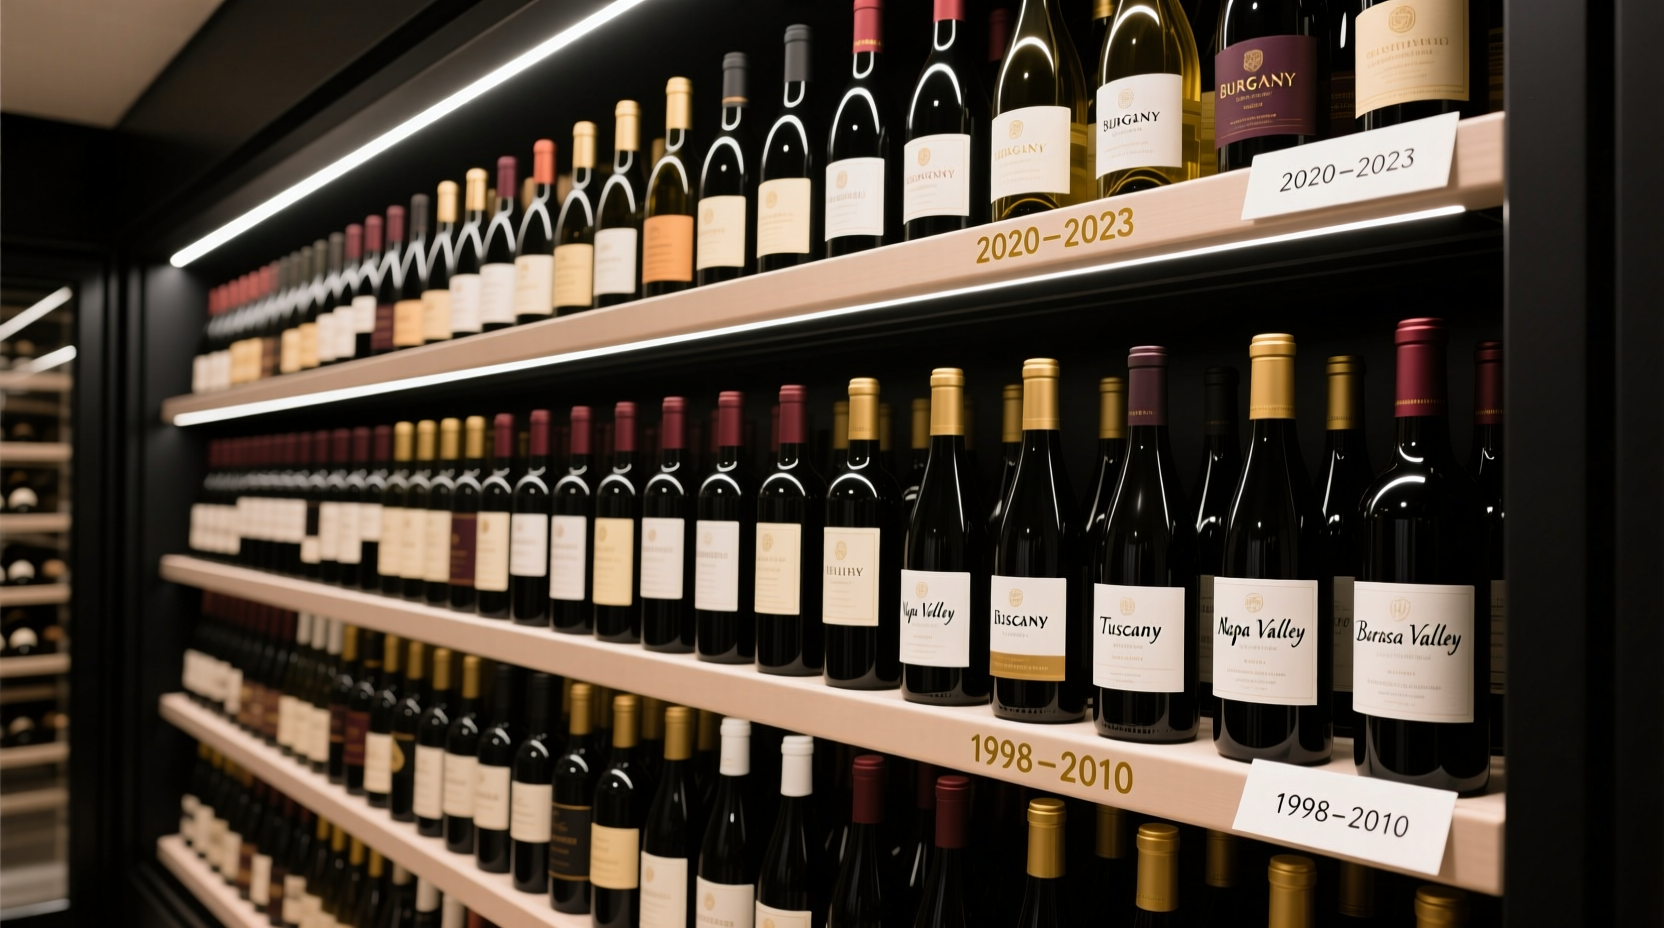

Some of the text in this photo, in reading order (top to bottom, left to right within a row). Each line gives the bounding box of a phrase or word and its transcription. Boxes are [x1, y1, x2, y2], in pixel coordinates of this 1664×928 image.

[1220, 72, 1297, 100] BURGANY
[1279, 148, 1415, 193] 2020–2023
[976, 207, 1134, 264] 2020–2023
[1100, 616, 1162, 644] Tuscany
[1256, 618, 1306, 648] Valley
[1410, 623, 1462, 656] Valley
[971, 734, 1134, 794] 1998–2010
[1277, 793, 1409, 838] 1998–2010
